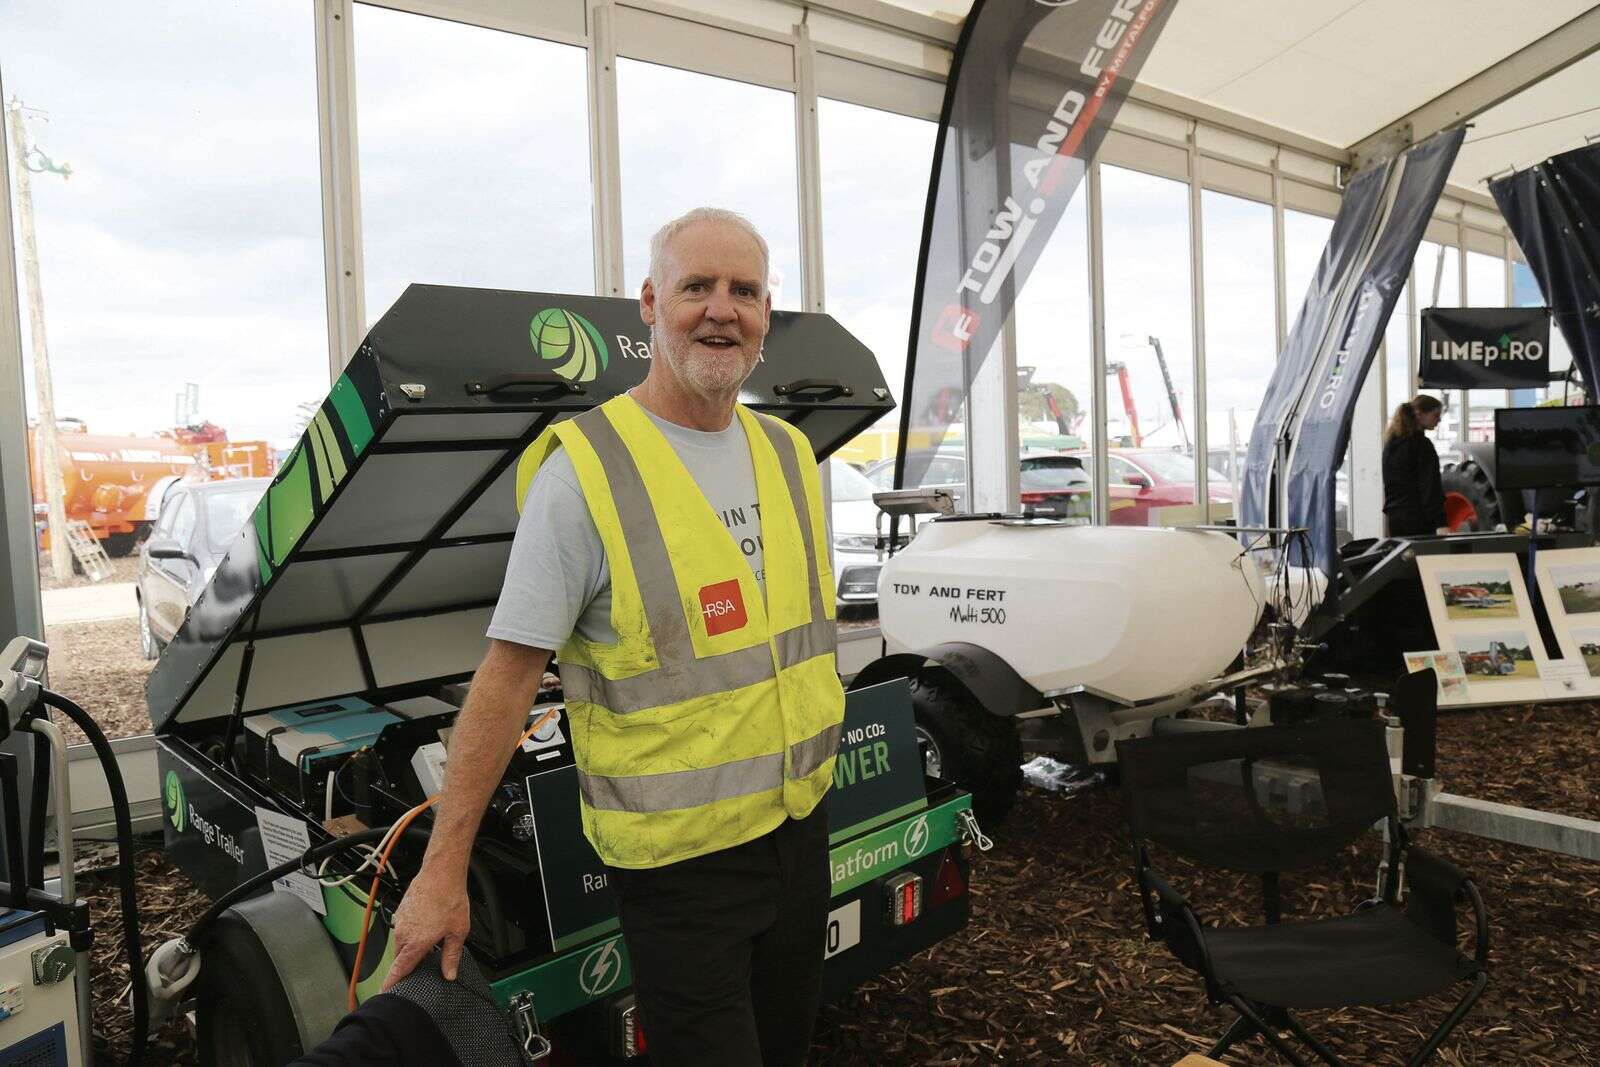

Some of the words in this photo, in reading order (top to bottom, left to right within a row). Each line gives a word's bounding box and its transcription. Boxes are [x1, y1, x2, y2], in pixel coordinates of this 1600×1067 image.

[1095, 76, 1111, 97] BY
[956, 196, 1023, 293] TOW
[1023, 90, 1086, 189] AND
[716, 506, 747, 528] IN
[929, 586, 961, 599] AND
[966, 588, 1007, 602] FERT
[703, 600, 736, 618] RSA
[950, 604, 978, 623] Multi
[980, 607, 1007, 625] 500
[847, 728, 864, 745] NO
[188, 803, 215, 845] Range
[214, 824, 245, 865] Trailer
